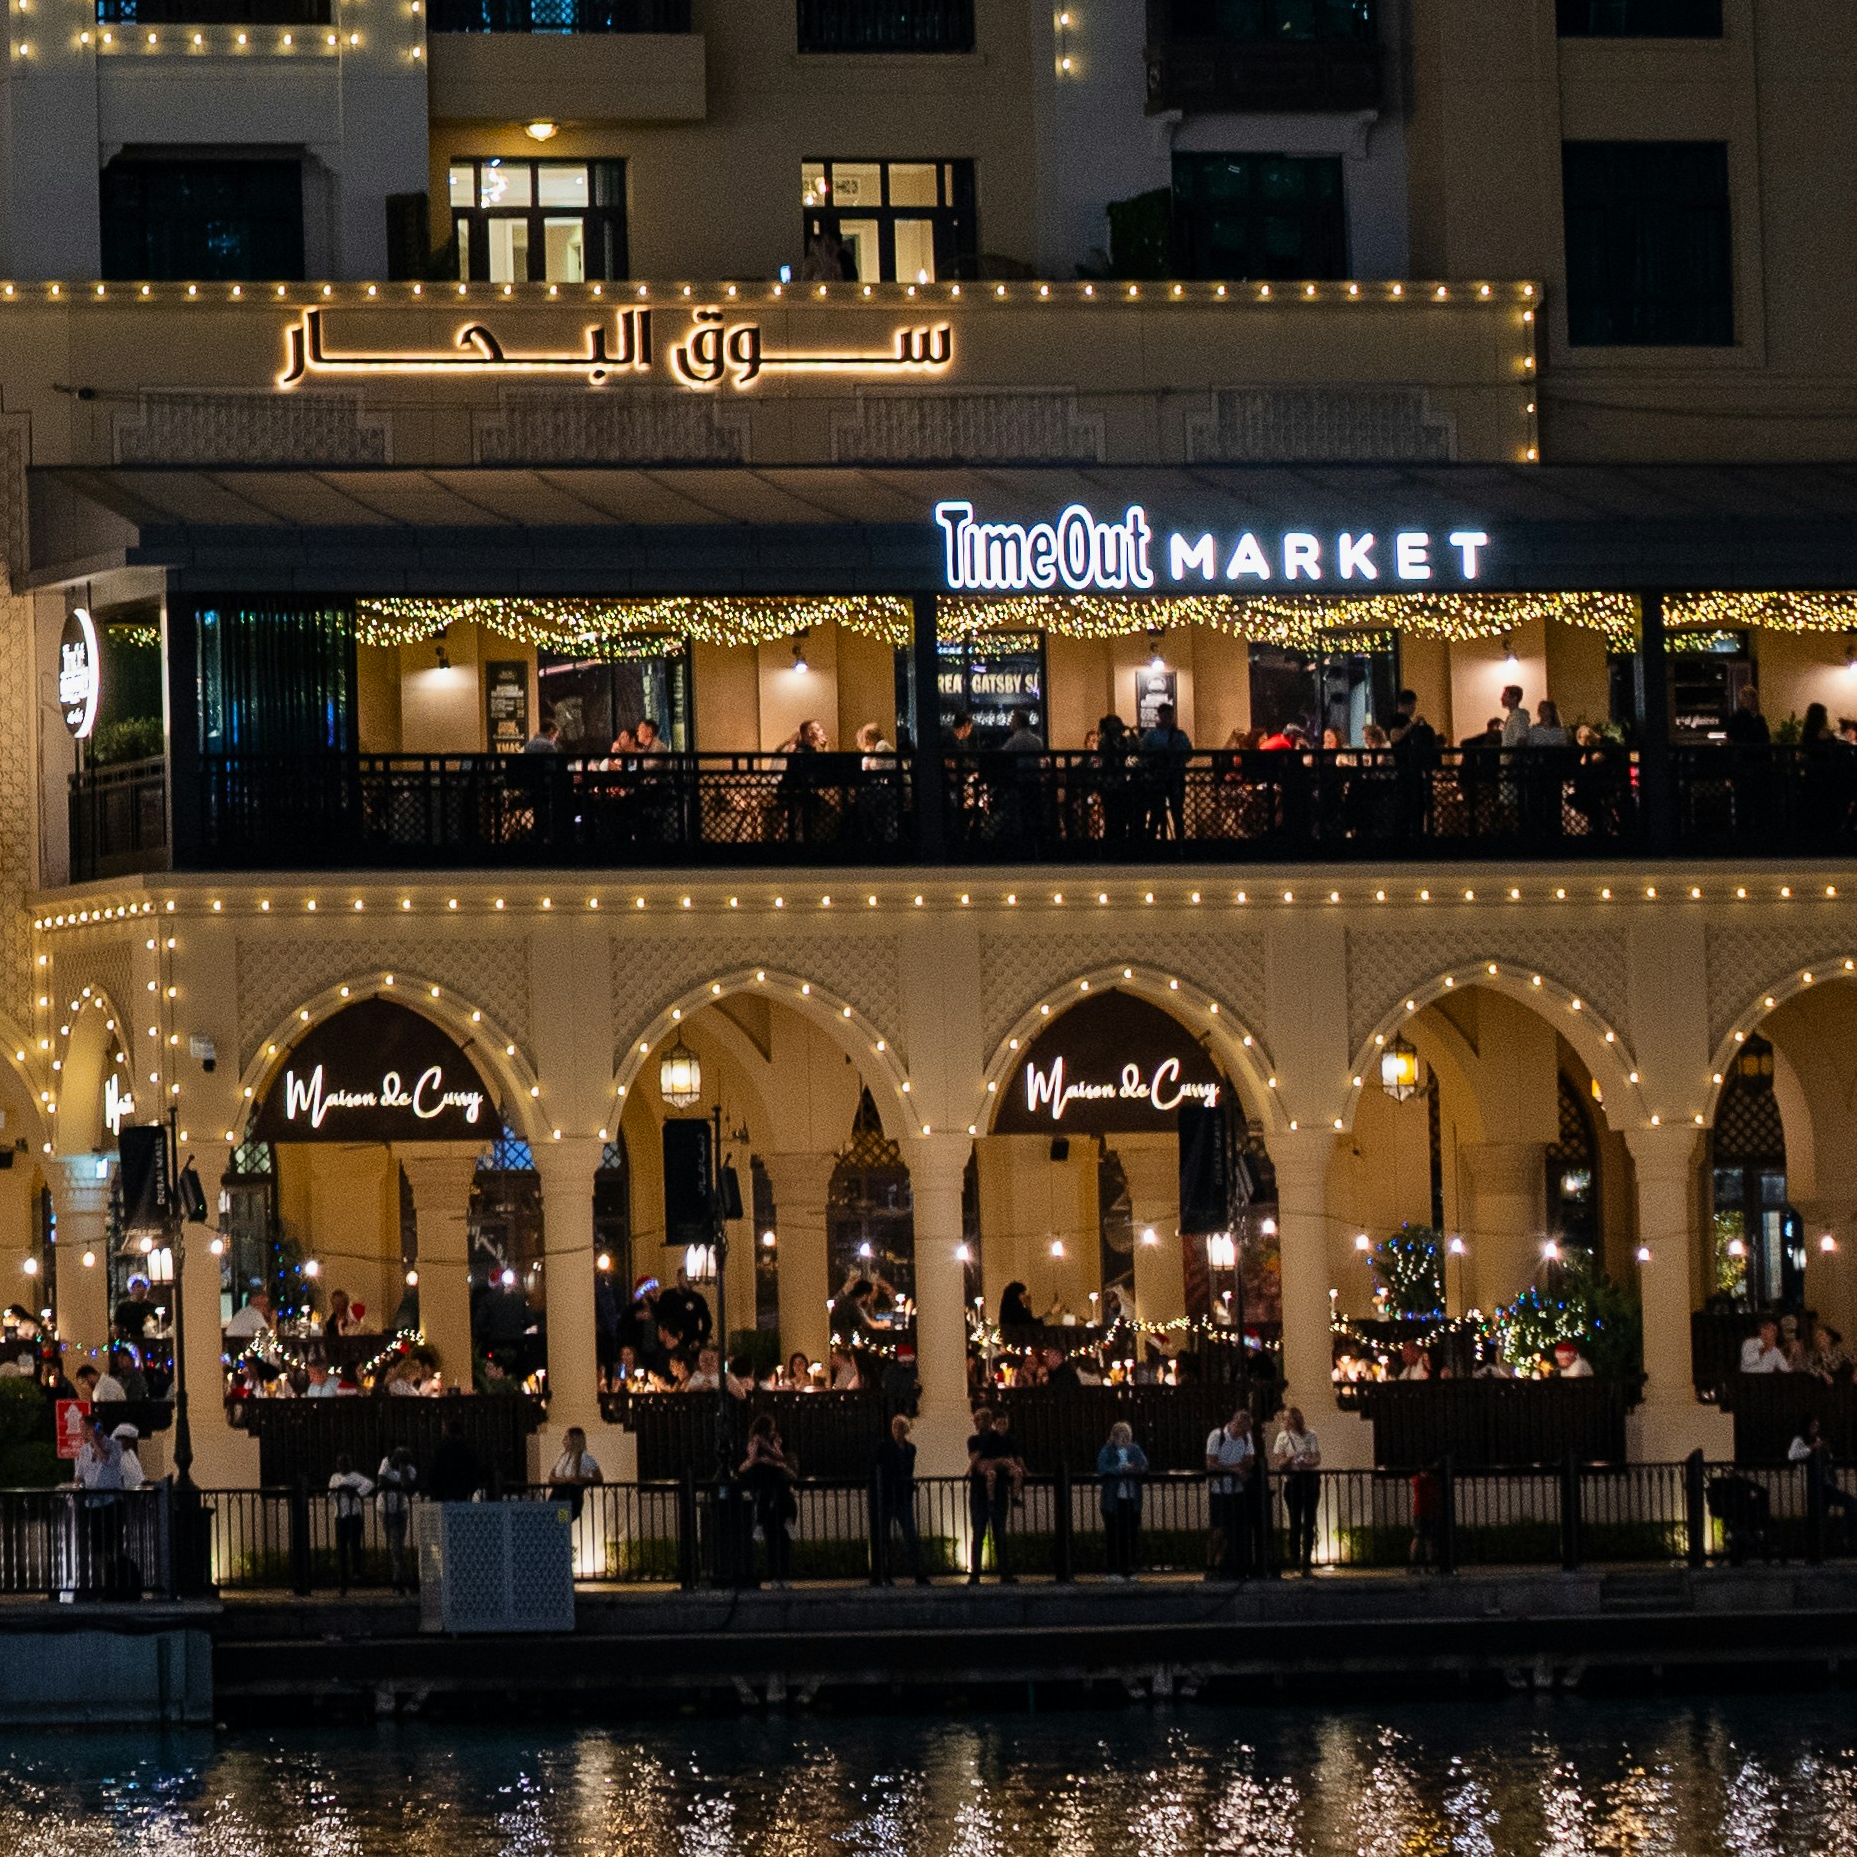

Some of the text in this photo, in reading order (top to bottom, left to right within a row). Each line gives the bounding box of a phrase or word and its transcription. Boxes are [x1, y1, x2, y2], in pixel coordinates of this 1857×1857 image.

[277, 307, 953, 390] سوق البحار
[1169, 530, 1488, 581] MARKET
[971, 673, 1022, 694] GATSBY
[286, 1064, 483, 1128] Maison de Curry
[1026, 1056, 1116, 1120] Maison
[1119, 1063, 1150, 1098] de
